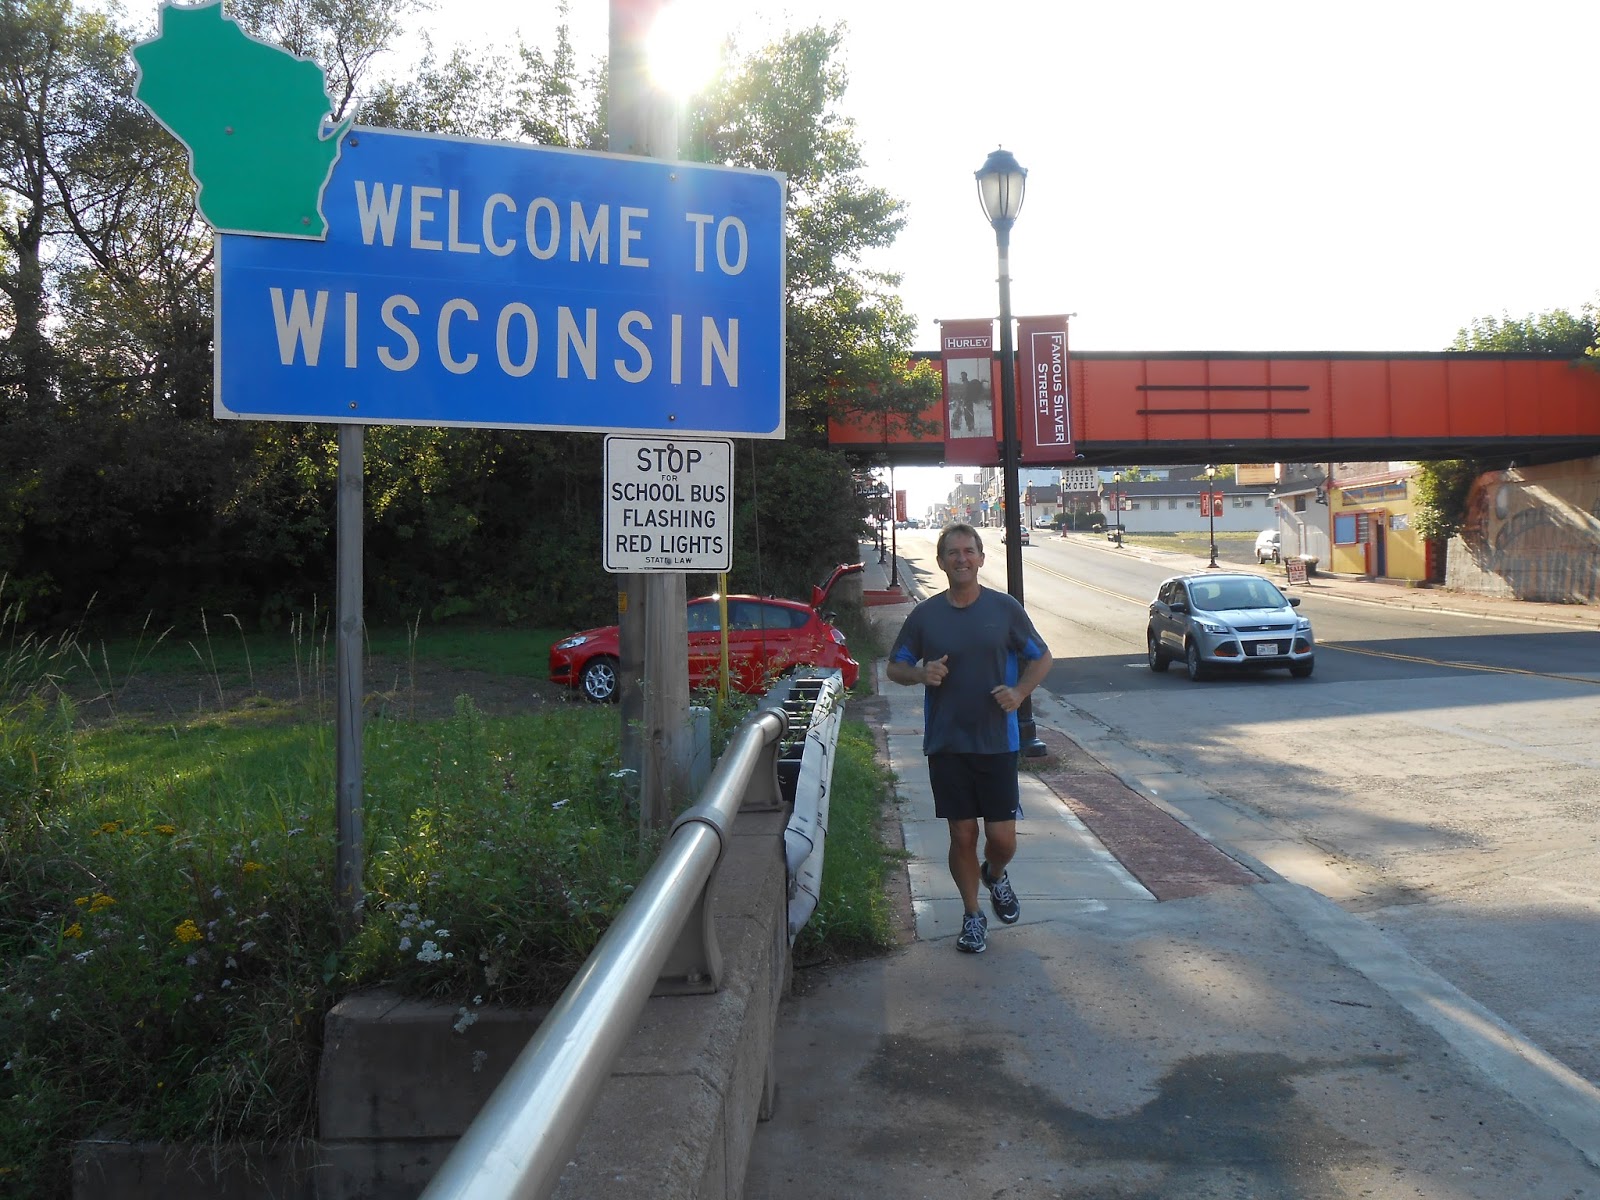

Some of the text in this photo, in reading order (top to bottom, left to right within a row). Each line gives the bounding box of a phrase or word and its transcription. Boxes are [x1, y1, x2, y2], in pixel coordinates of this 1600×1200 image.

[354, 180, 749, 276] WELCOME TO
[269, 287, 739, 388] WISCONSIN
[947, 338, 989, 348] HURLEY
[1038, 363, 1049, 416] STREET
[1051, 335, 1065, 442] FAMOUS SILVER
[637, 447, 702, 473] STOP
[661, 474, 678, 482] FOR
[1065, 482, 1095, 490] MOTEL
[611, 482, 726, 503] SCHOOL BUS
[623, 508, 716, 528] FLASHING
[616, 534, 723, 554] RED LIGHTS
